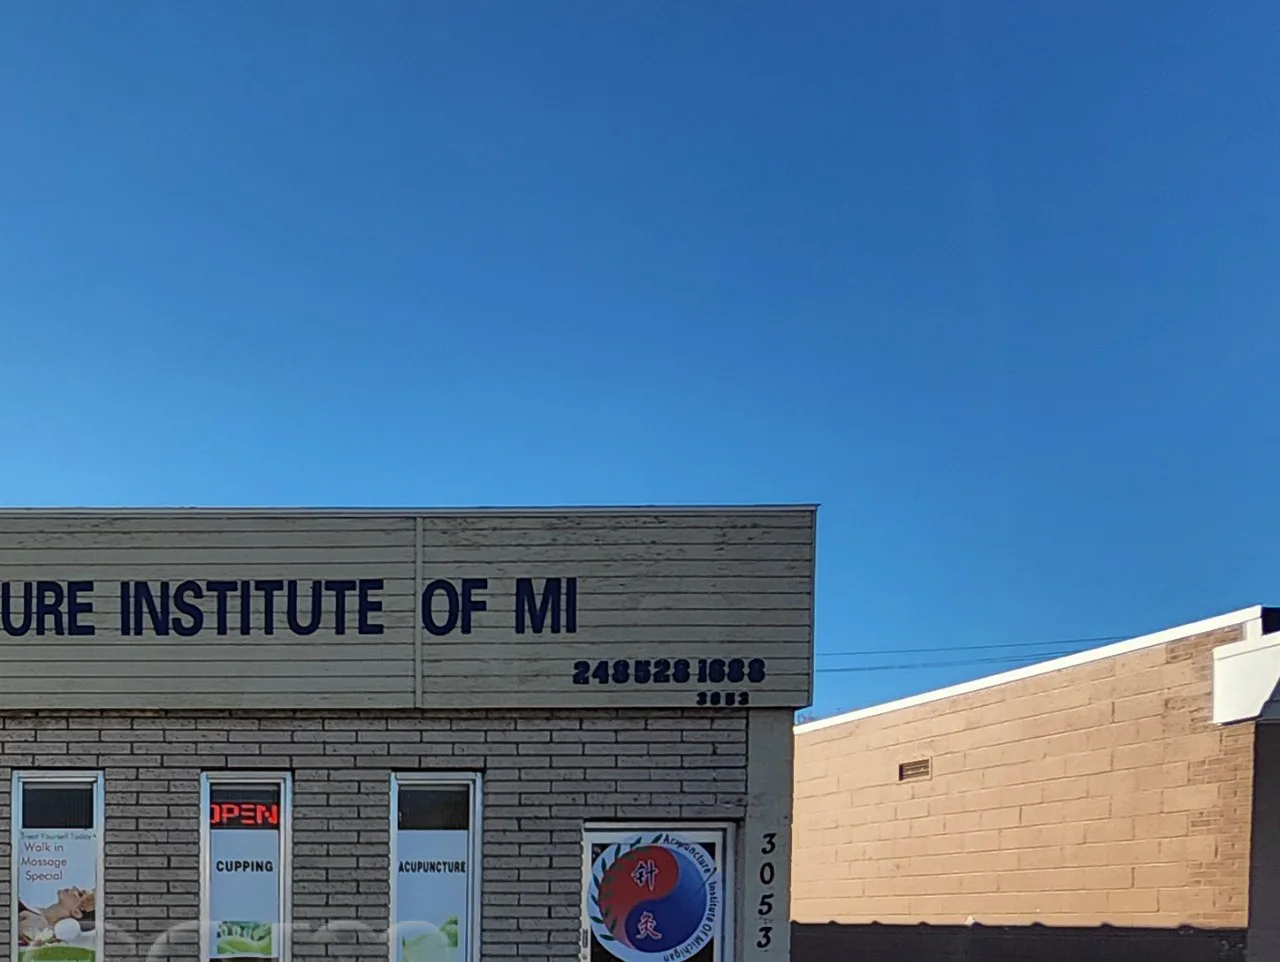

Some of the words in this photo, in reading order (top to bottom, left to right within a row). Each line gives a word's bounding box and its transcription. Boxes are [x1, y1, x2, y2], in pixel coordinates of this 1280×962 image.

[120, 578, 385, 637] INSTITUTE
[421, 578, 488, 636] OF
[515, 577, 577, 635] MI
[23, 841, 51, 853] Walk
[54, 841, 64, 852] in
[20, 856, 68, 868] Massage
[216, 860, 274, 873] CUPPING
[398, 860, 467, 874] ACUPUNCTURE
[25, 870, 63, 882] Special
[756, 832, 777, 949] 3053
[705, 881, 720, 923] Institute
[663, 934, 705, 962] Michigan
